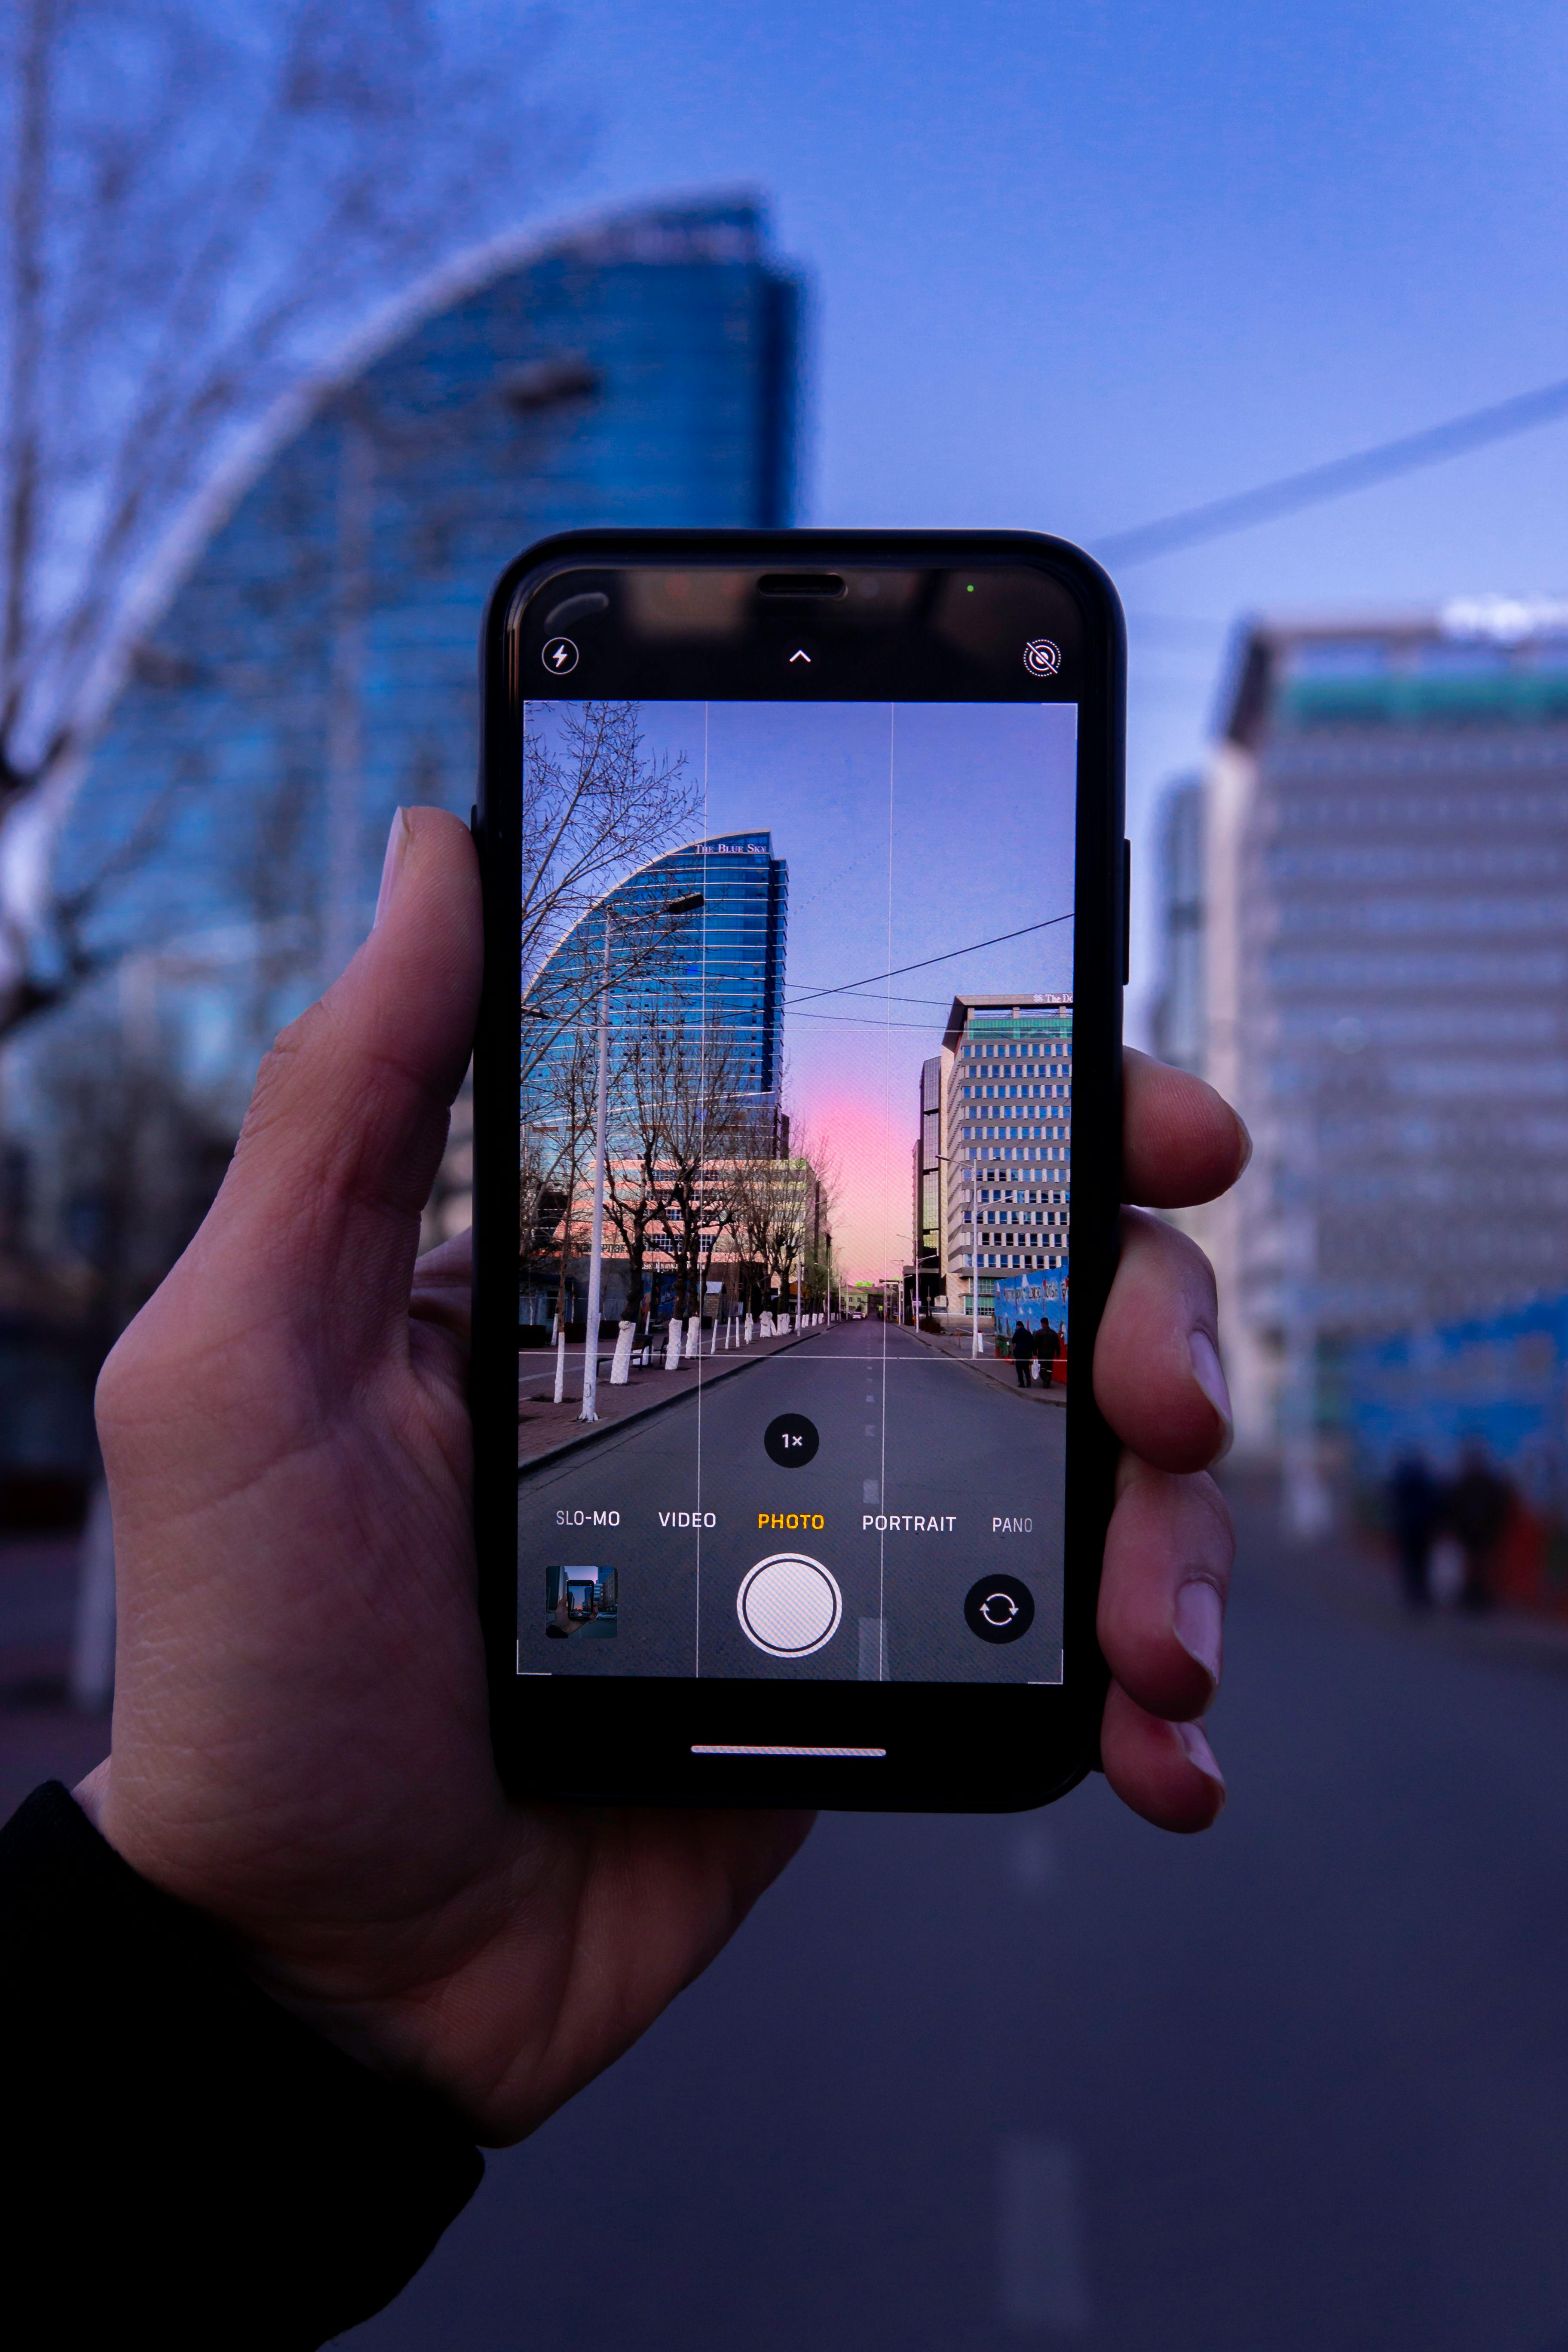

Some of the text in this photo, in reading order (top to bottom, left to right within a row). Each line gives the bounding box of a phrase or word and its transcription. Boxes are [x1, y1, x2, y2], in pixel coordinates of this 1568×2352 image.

[718, 844, 744, 853] BLUE
[747, 844, 766, 853] SKY
[1045, 994, 1061, 1003] The
[556, 1510, 1033, 1533] SLO-MO VIDEO PHOTO PORTRAIT PANO
